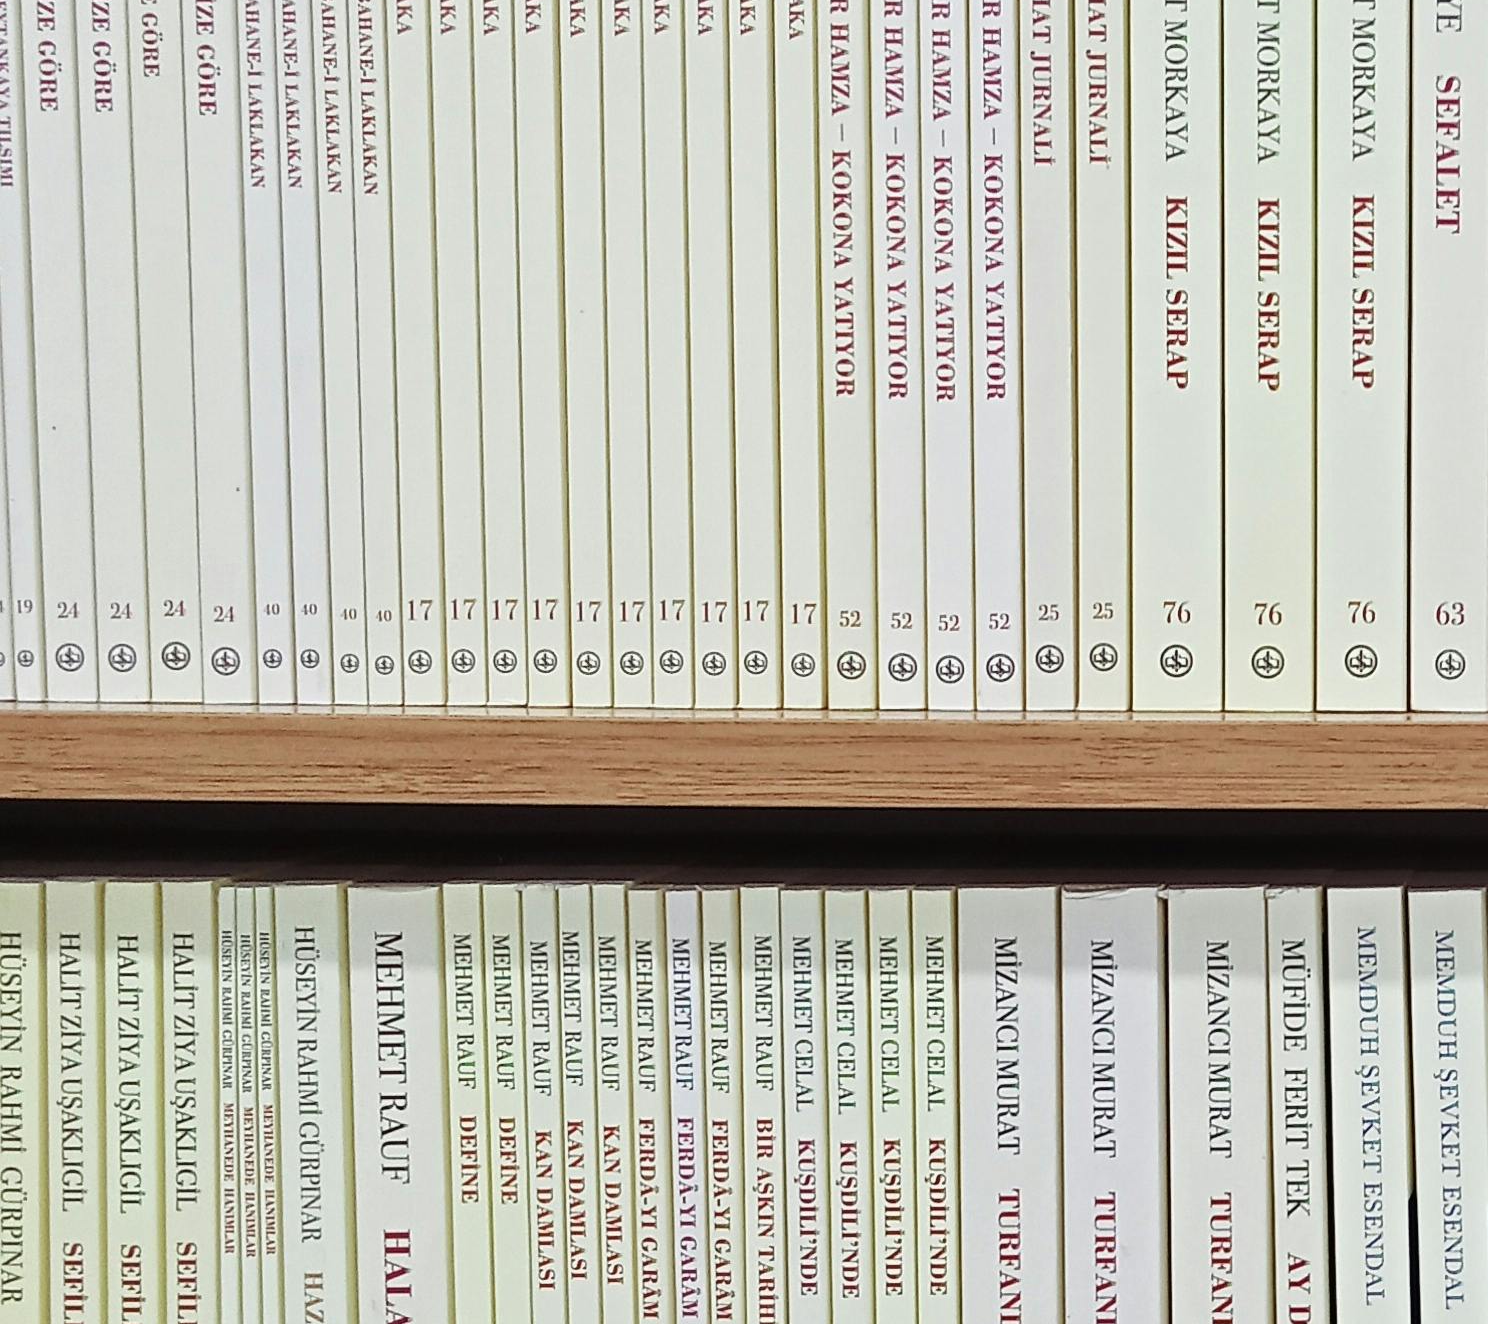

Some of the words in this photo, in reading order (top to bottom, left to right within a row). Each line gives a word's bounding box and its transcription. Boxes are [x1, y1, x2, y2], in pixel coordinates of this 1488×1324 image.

[37, 39, 63, 113] GÖRE
[1256, 20, 1281, 165] MORKAYA
[1435, 74, 1462, 235] SEFALET
[831, 149, 854, 270] KOKONA
[1256, 197, 1281, 284] KIZIL
[833, 276, 856, 397] YATIYOR
[1256, 290, 1281, 392] SERAP
[56, 601, 79, 620] 24
[263, 602, 281, 616] 40
[532, 598, 559, 621] 17
[838, 609, 863, 628] 52
[1253, 601, 1283, 627] 76
[1435, 600, 1465, 627] 63
[171, 932, 199, 1011] HALİT
[373, 930, 408, 1085] MEHMET
[1090, 939, 1119, 1055] MİZANCI
[1356, 925, 1380, 1057] MEMDUH
[173, 1013, 199, 1075] ZİYA
[169, 1076, 202, 1213] UŞAKLIGİL
[377, 1091, 411, 1185] RAUF
[1091, 1062, 1117, 1159] MURAT
[1353, 1064, 1383, 1175] ŞEVKET
[1363, 1181, 1386, 1307] ESENDAL
